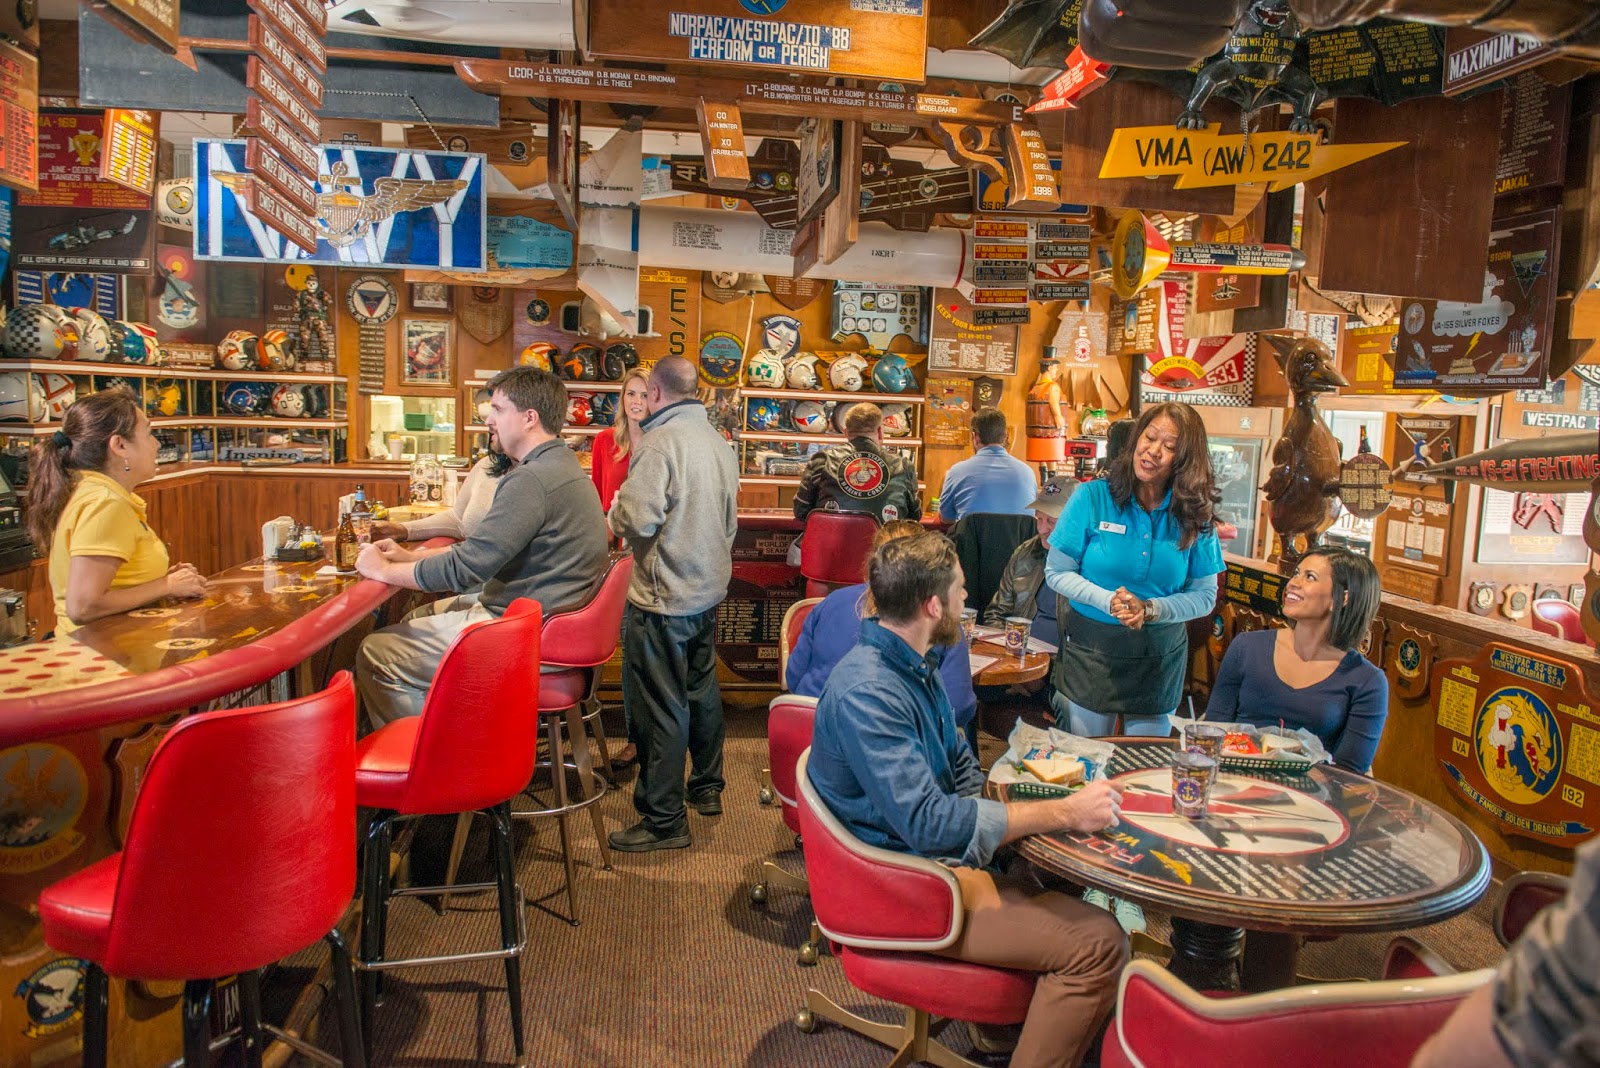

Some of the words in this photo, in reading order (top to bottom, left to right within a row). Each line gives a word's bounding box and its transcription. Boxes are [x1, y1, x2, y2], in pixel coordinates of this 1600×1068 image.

[1263, 31, 1275, 39] CO
[691, 36, 753, 62] PERFORM
[758, 46, 776, 59] OR
[781, 44, 828, 68] PERISH
[1449, 33, 1514, 81] MAXIMUM
[1402, 76, 1416, 85] MAY
[1012, 106, 1023, 120] E
[721, 138, 732, 147] XO
[1136, 137, 1193, 167] VMA
[1204, 144, 1254, 176] (AW)
[1263, 140, 1311, 171] 242
[1033, 186, 1053, 196] 1988
[1489, 251, 1512, 262] STORM
[936, 304, 952, 319] KEEP
[952, 317, 968, 329] YOUR
[1454, 319, 1477, 328] SILVER
[1478, 316, 1500, 327] FOXES
[1078, 326, 1088, 337] E
[1152, 359, 1177, 375] EXTENDED
[1206, 359, 1239, 386] 533
[1212, 385, 1238, 394] SHIELD
[1148, 393, 1167, 402] THE
[1169, 394, 1204, 404] HAWKS
[1527, 412, 1587, 429] WESTPAC
[843, 453, 863, 466] UNITED
[867, 453, 885, 467] STATES
[1520, 454, 1600, 482] FIGHTING
[841, 481, 862, 496] MARINE
[867, 483, 885, 496] CORPS
[1500, 652, 1530, 669] WESTPAC
[1534, 662, 1557, 676] 83-84
[1494, 659, 1514, 671] NORTH
[1517, 665, 1545, 681] ARABIAN
[1547, 673, 1561, 686] SEA
[1456, 740, 1466, 754] VA
[1563, 787, 1583, 805] 192
[1458, 780, 1478, 800] WORLD
[1478, 795, 1503, 818] FAMOUS
[1505, 813, 1530, 829] GOLDEN
[1532, 823, 1565, 836] DRAGONS
